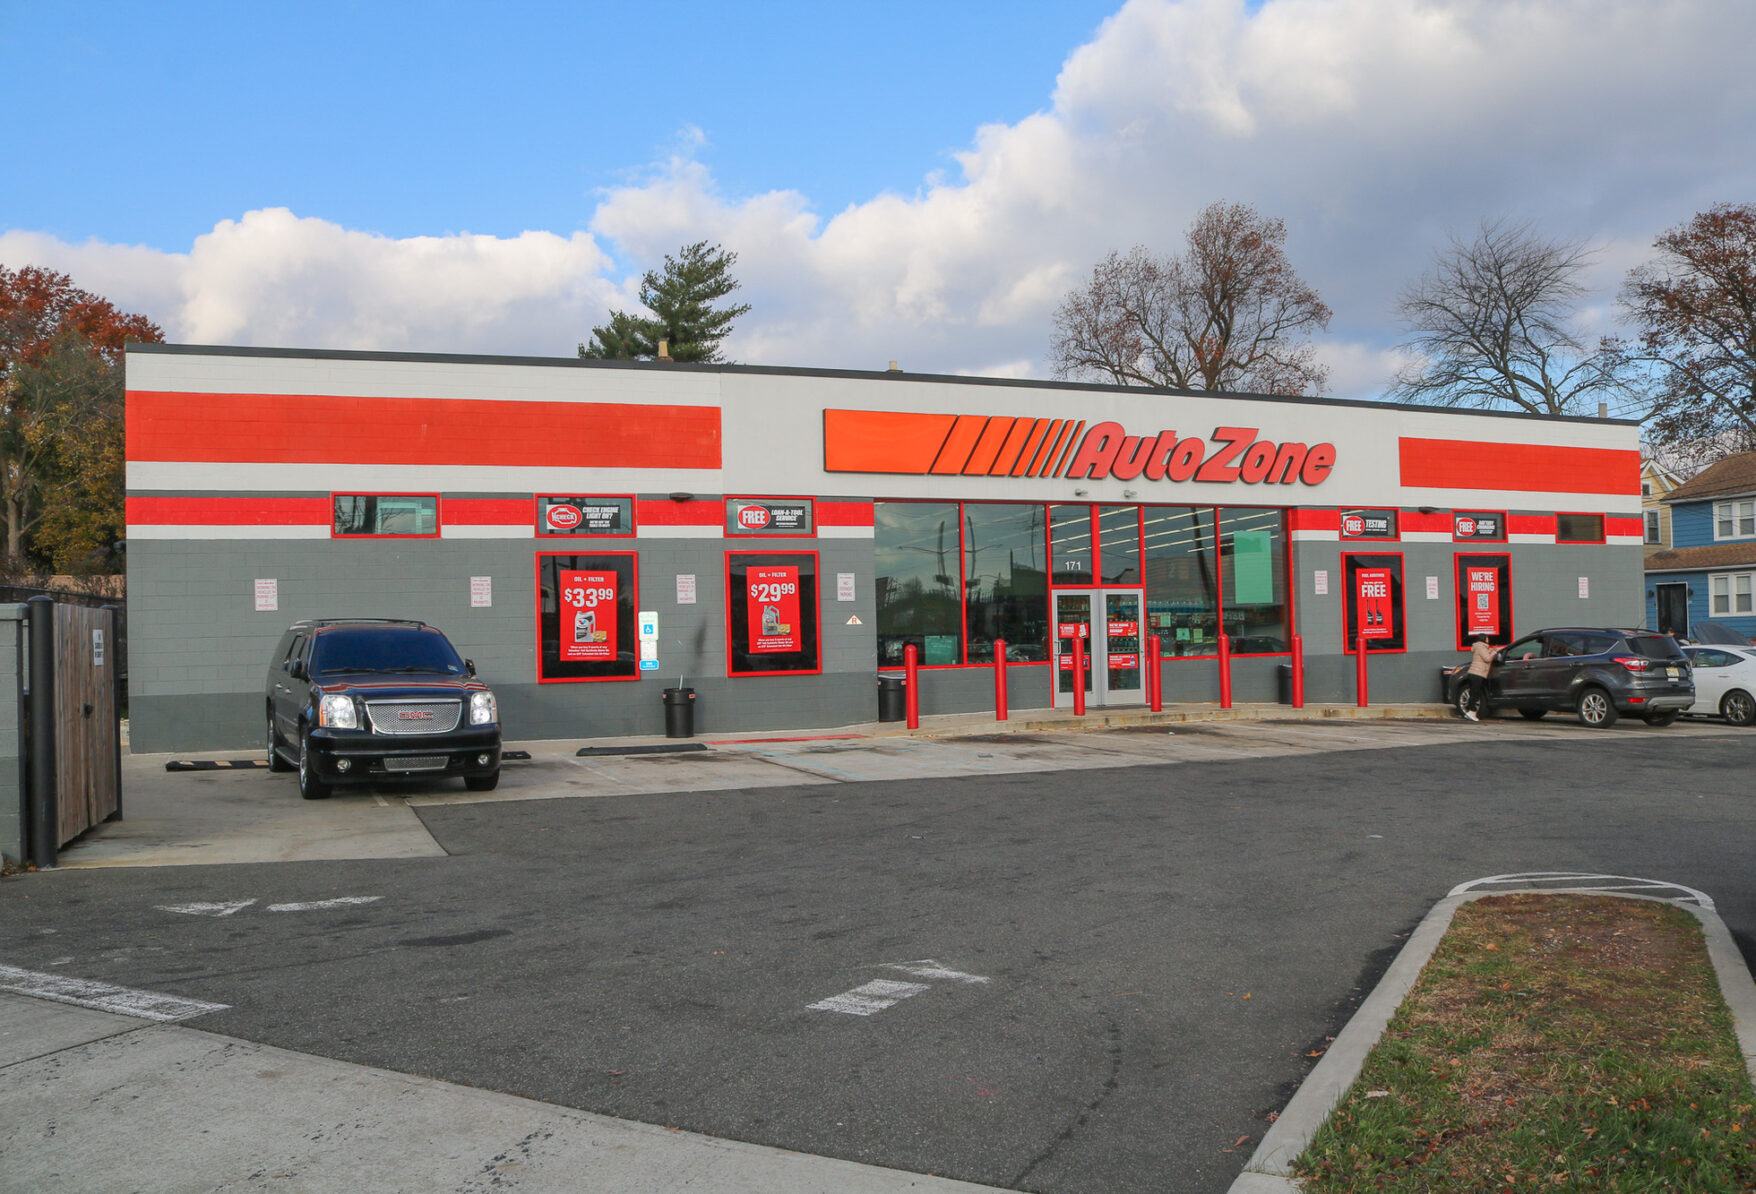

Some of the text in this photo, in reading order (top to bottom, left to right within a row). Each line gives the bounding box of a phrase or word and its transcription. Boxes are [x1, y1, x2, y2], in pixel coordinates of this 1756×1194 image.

[1065, 421, 1337, 486] AutoZone
[742, 510, 766, 524] FREE
[1346, 520, 1362, 532] FREE
[1365, 519, 1387, 528] TESTING
[1459, 521, 1474, 532] FREE
[1065, 560, 1081, 570] 171
[1471, 571, 1494, 581] WE'RE
[1361, 584, 1387, 598] FREE
[1471, 582, 1495, 592] HIRING
[398, 711, 433, 719] GMC
